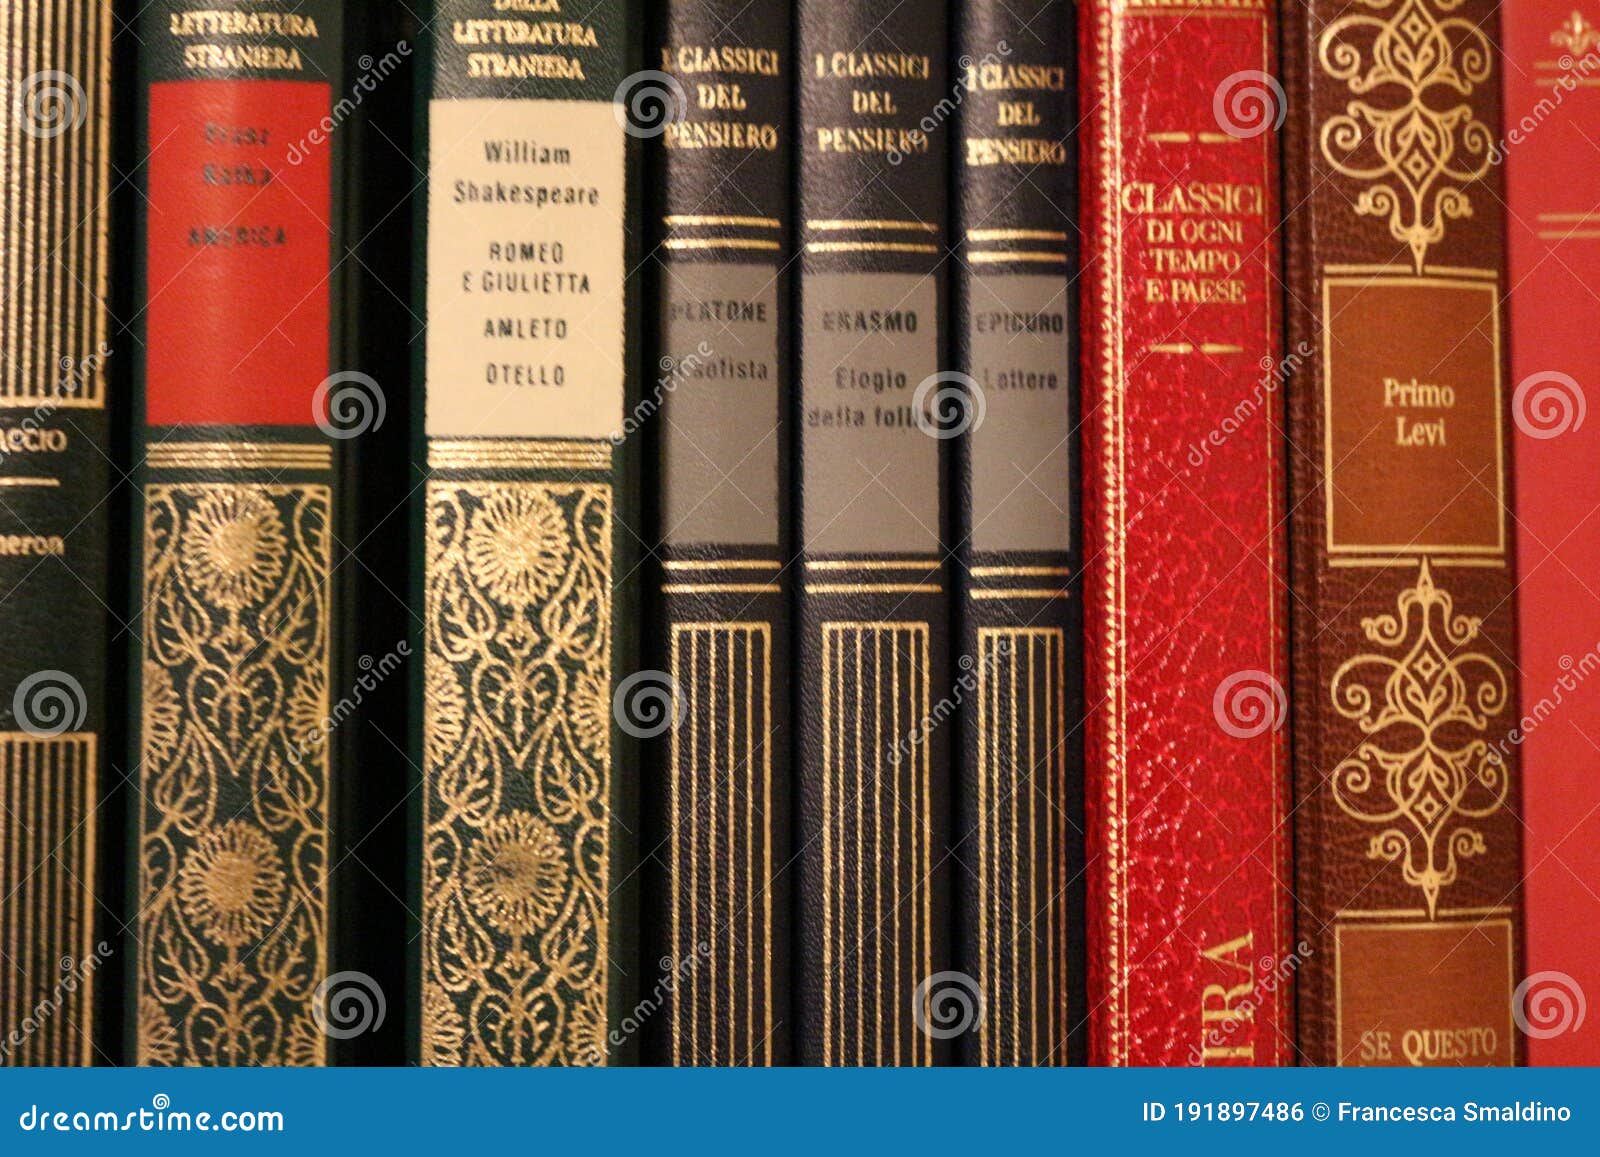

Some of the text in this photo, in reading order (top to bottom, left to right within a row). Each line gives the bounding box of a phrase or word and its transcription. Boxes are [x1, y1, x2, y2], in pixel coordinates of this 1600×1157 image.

[170, 10, 319, 38] LETTERATURA
[453, 19, 599, 47] LETTERATURA
[184, 44, 303, 71] STRANIERA
[467, 53, 586, 80] STRANIERA
[677, 46, 779, 75] CLASSICI
[815, 52, 930, 79] I CLASSICI
[966, 63, 1065, 92] I CLASSICI
[697, 84, 747, 110] DEL
[852, 90, 897, 115] DEL
[998, 101, 1040, 126] DEL
[663, 121, 778, 150] PENSIERO
[816, 127, 929, 152] PENSIERO
[484, 139, 571, 163] William
[966, 137, 1067, 166] PENSIERO
[453, 180, 599, 208] Shakespeare
[1121, 181, 1264, 216] CLASSICI
[1147, 219, 1244, 244] DI OGNI
[489, 241, 564, 263] ROMEO
[1150, 249, 1241, 275] TEMPO
[463, 271, 590, 293] E GIULIETTA
[1147, 279, 1246, 304] E PAESE
[484, 318, 567, 339] AMLETO
[823, 309, 918, 333] ERASMO
[976, 312, 1064, 334] EPICURO
[486, 363, 565, 386] OTELLO
[835, 366, 907, 394] Elogio
[1383, 377, 1455, 408] Primo
[1395, 416, 1447, 447] Levi
[1361, 1027, 1497, 1067] SE QUESTO
